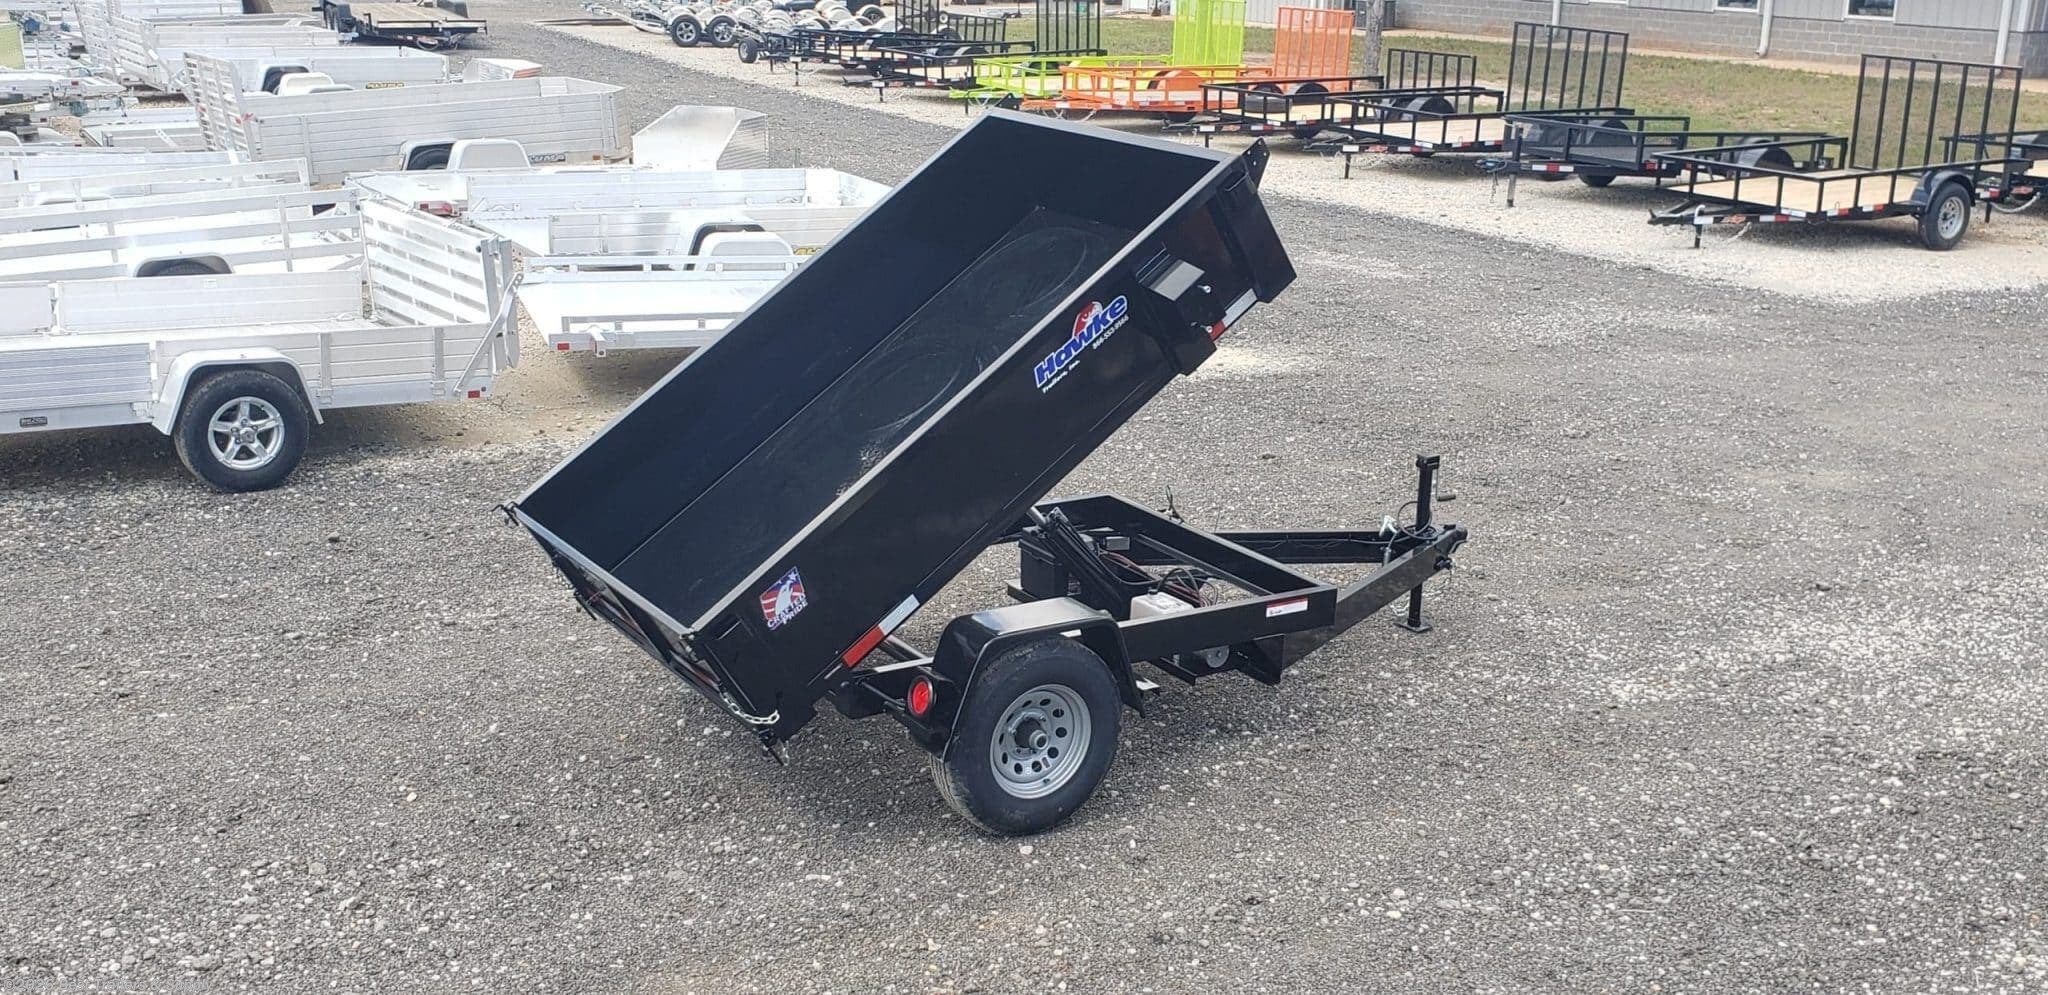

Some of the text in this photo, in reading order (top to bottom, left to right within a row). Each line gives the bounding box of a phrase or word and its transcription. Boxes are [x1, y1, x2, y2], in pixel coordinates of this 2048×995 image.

[1034, 295, 1128, 388] Hawke
[767, 593, 807, 628] CRAFTED
[782, 600, 809, 625] PRIDE
